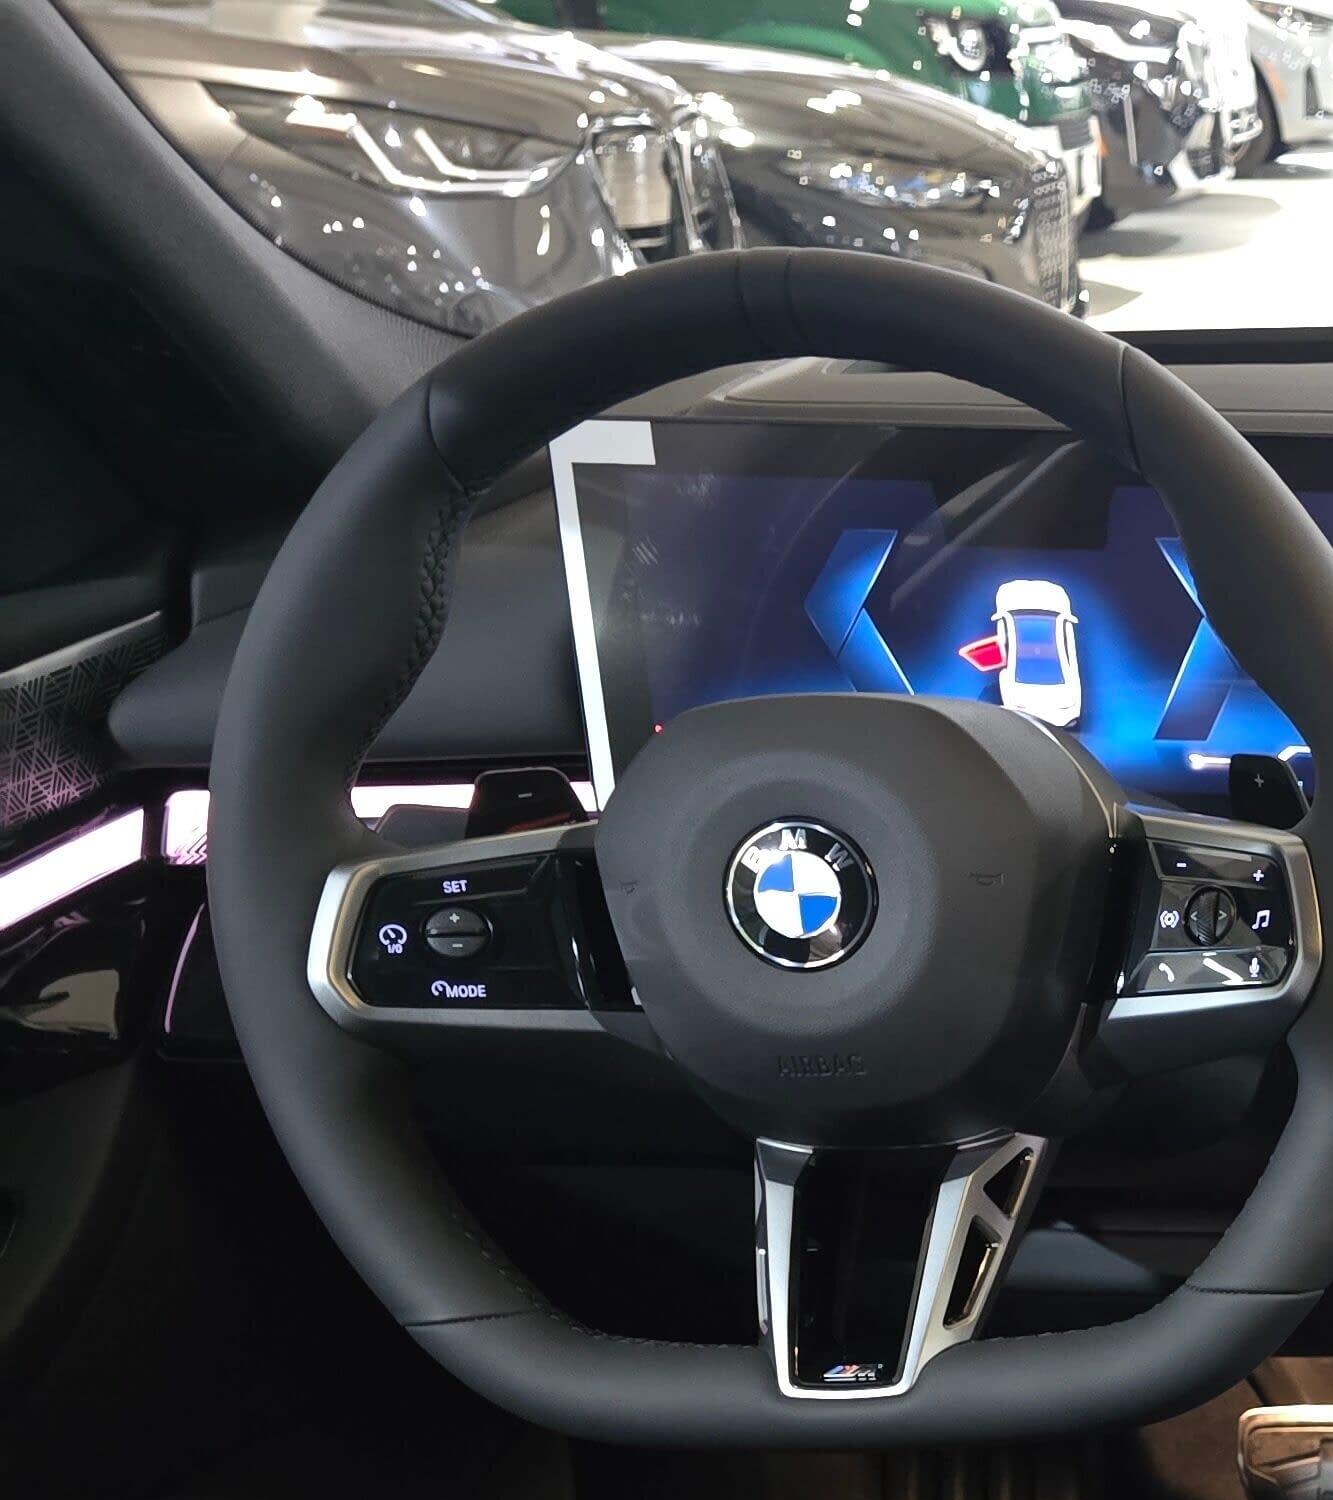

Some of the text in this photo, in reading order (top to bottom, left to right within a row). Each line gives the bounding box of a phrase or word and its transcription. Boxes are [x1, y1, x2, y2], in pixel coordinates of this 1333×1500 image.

[741, 828, 854, 873] BMW
[442, 878, 469, 894] SET
[446, 984, 487, 999] MODE
[776, 1055, 866, 1078] AIRBAG
